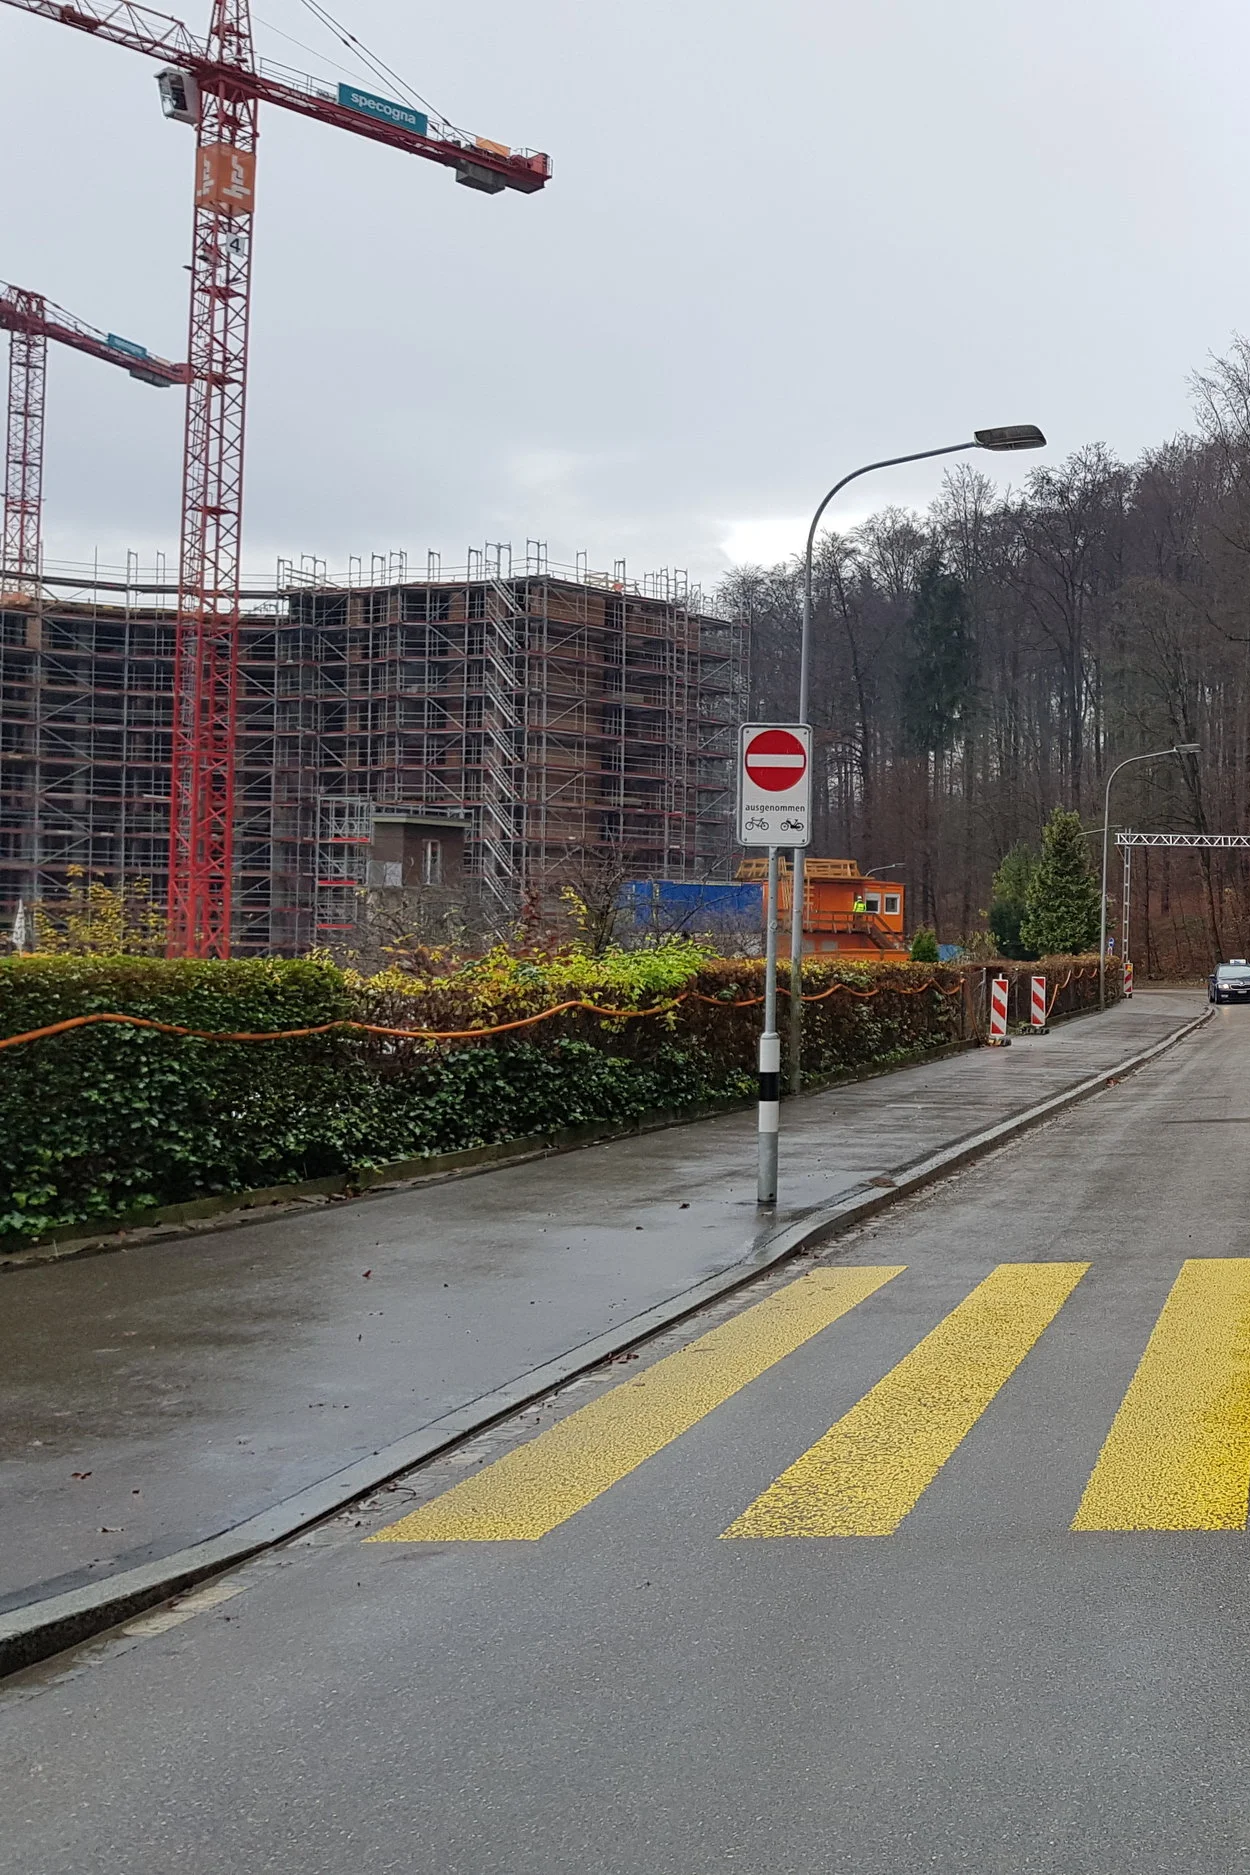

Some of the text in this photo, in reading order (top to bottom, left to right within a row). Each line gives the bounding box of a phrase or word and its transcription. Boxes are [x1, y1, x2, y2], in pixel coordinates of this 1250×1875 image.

[351, 93, 416, 125] specogna
[229, 238, 240, 253] 4
[745, 804, 805, 813] ausgenommen
